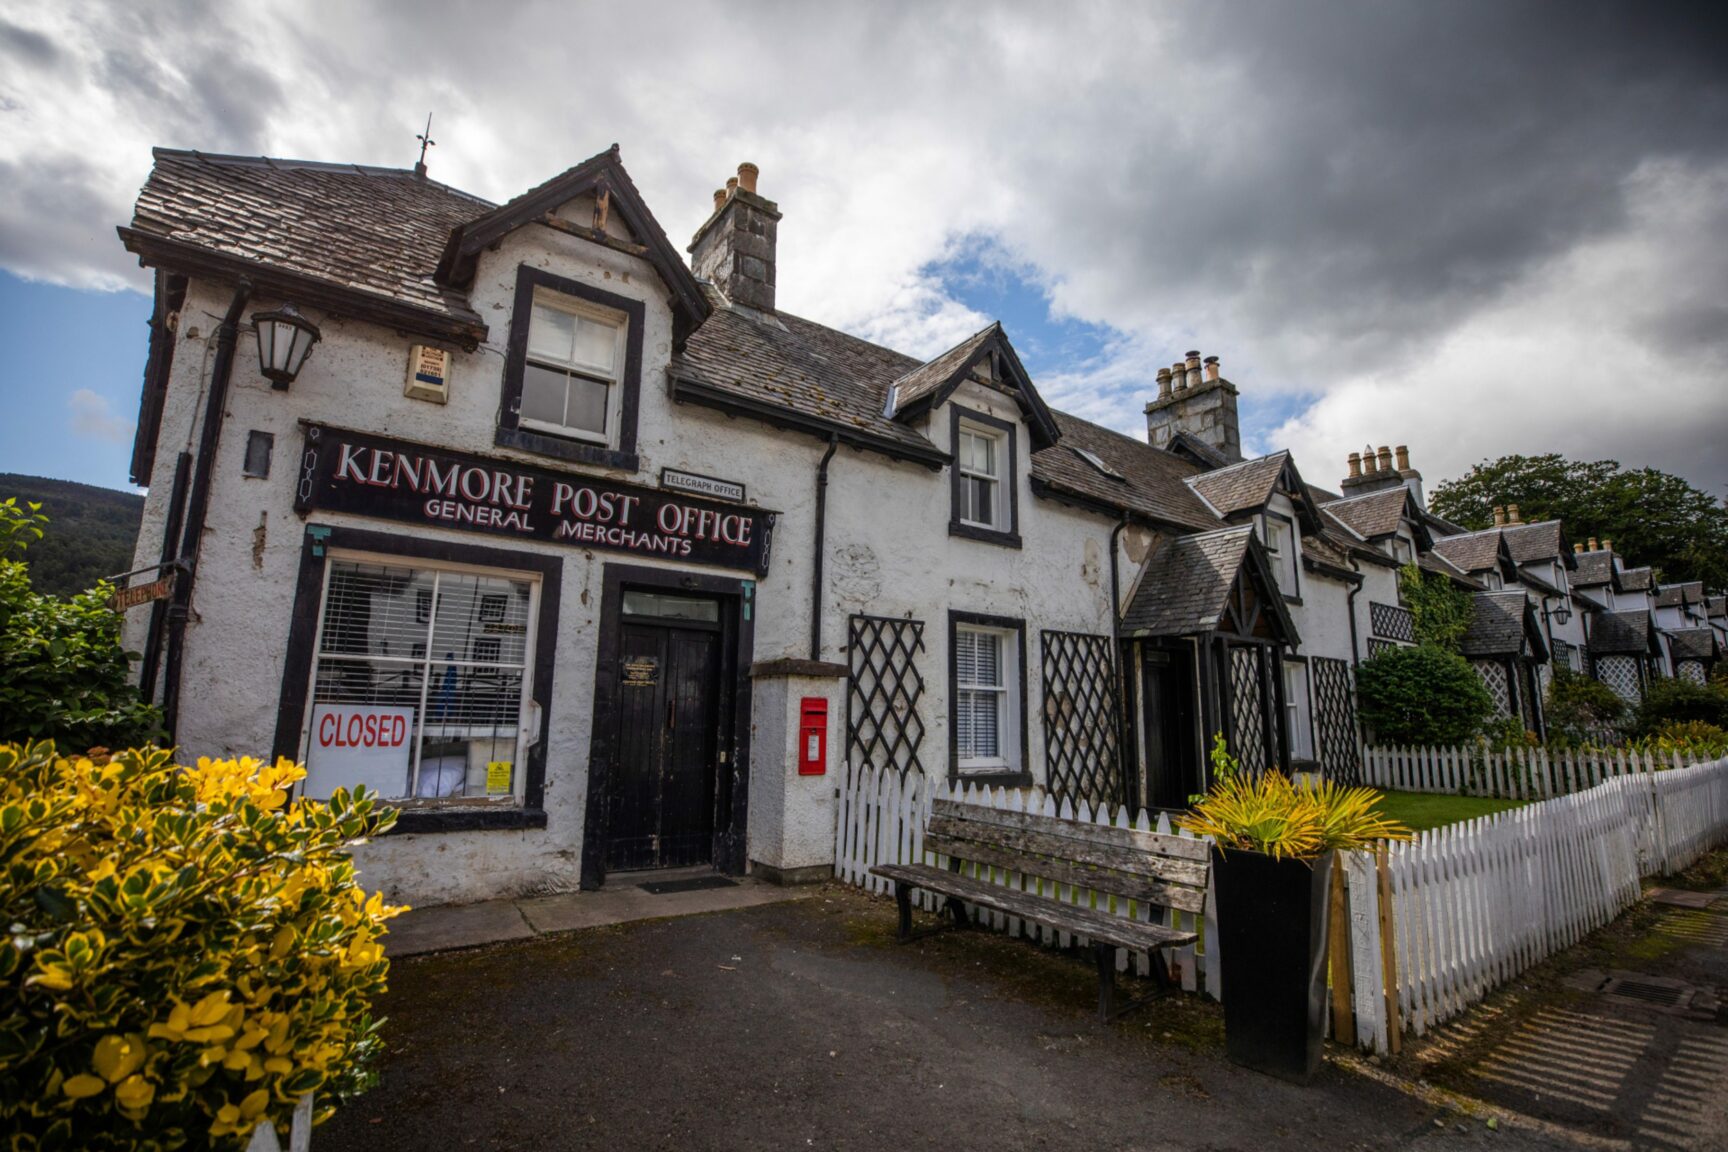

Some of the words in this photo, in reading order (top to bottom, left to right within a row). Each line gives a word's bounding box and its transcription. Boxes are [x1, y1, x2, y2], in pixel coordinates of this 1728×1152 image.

[333, 443, 534, 510] KENMORE
[550, 482, 639, 526] POST
[657, 503, 753, 547] OFFICE
[666, 474, 712, 490] TELEGRAPH
[713, 483, 741, 496] OFFICE
[424, 499, 534, 531] GENERAL
[560, 519, 692, 556] MERCHANTS
[319, 713, 406, 747] CLOSED
